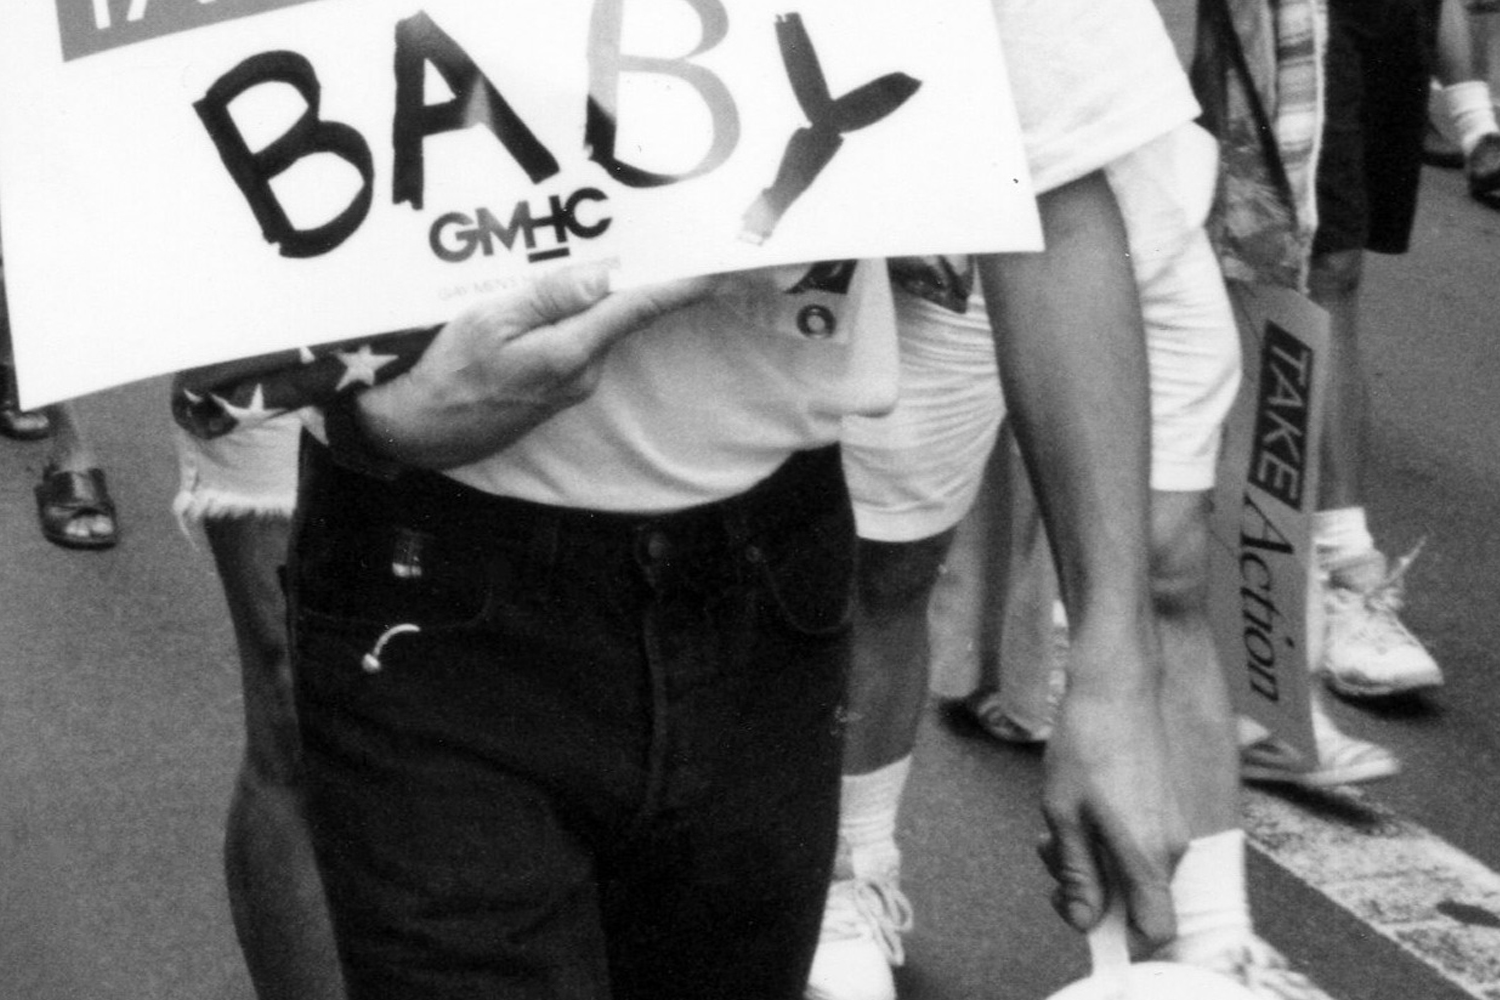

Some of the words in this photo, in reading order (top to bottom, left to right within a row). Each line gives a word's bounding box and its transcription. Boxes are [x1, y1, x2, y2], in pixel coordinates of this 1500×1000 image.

[428, 187, 613, 264] GMHC
[1256, 344, 1308, 501] TAKE
[1238, 494, 1296, 704] Action
